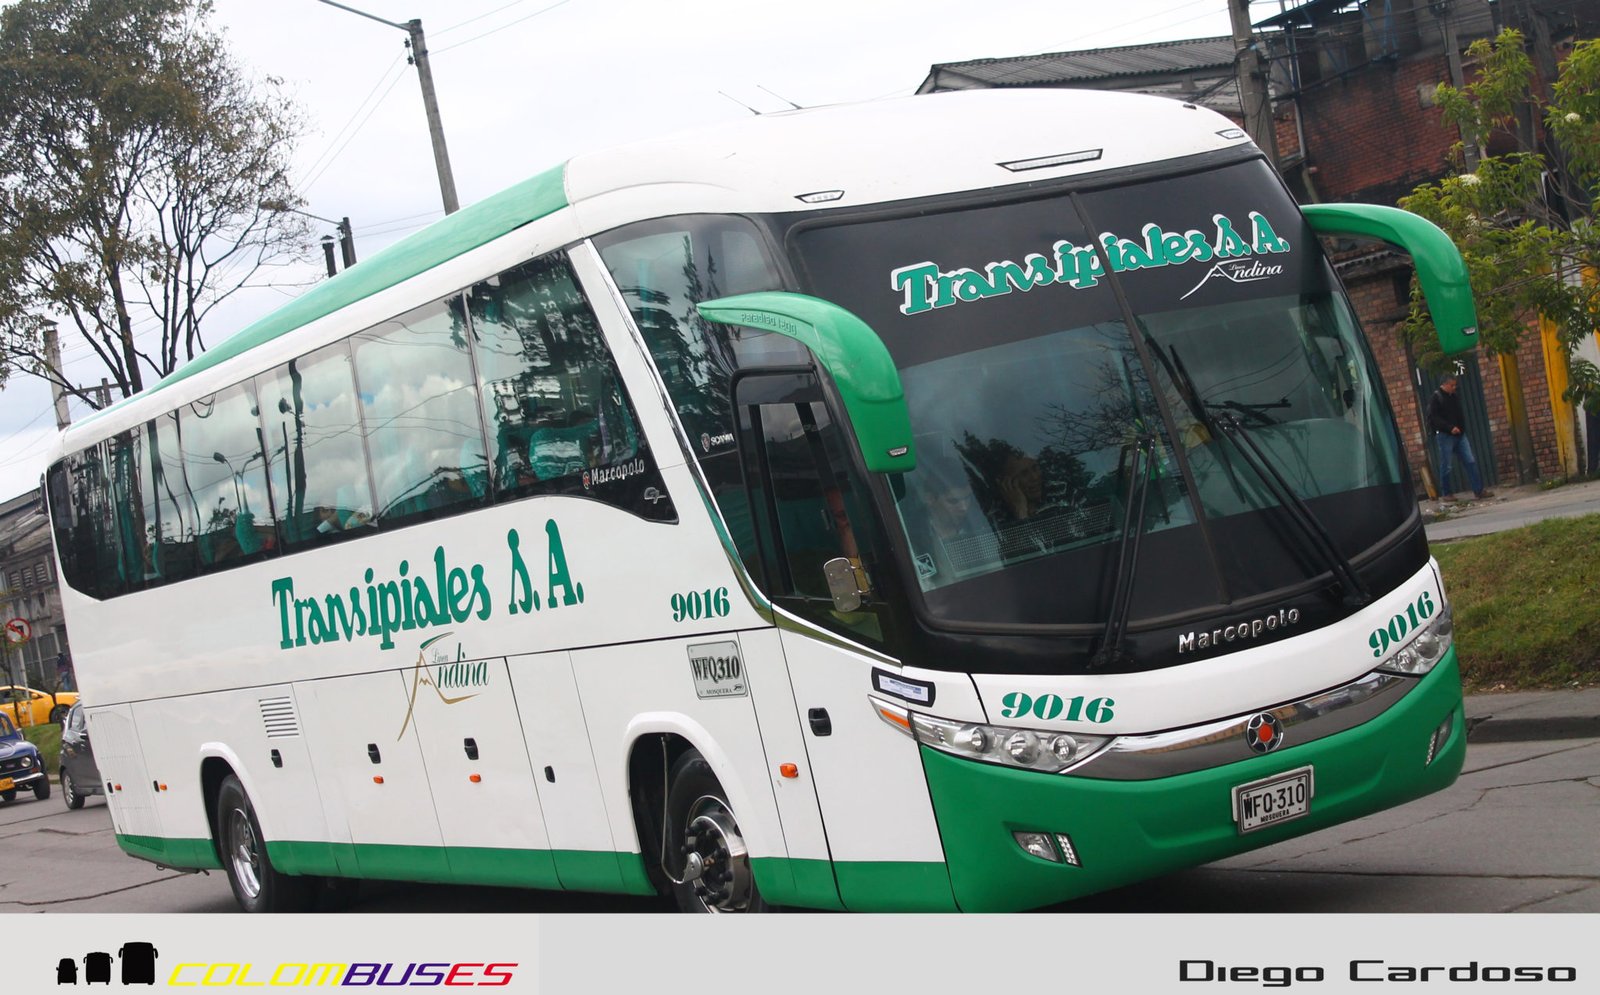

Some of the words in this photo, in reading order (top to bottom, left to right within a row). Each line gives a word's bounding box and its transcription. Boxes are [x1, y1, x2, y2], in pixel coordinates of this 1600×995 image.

[890, 222, 1214, 316] Transipiales
[591, 458, 645, 486] Marcopolo
[272, 545, 492, 650] Transipiales
[670, 590, 731, 622] 9016
[1178, 608, 1300, 653] Marcopolo
[1368, 591, 1435, 658] 9016
[691, 655, 740, 684] WFQ310
[1001, 692, 1115, 724] 9016
